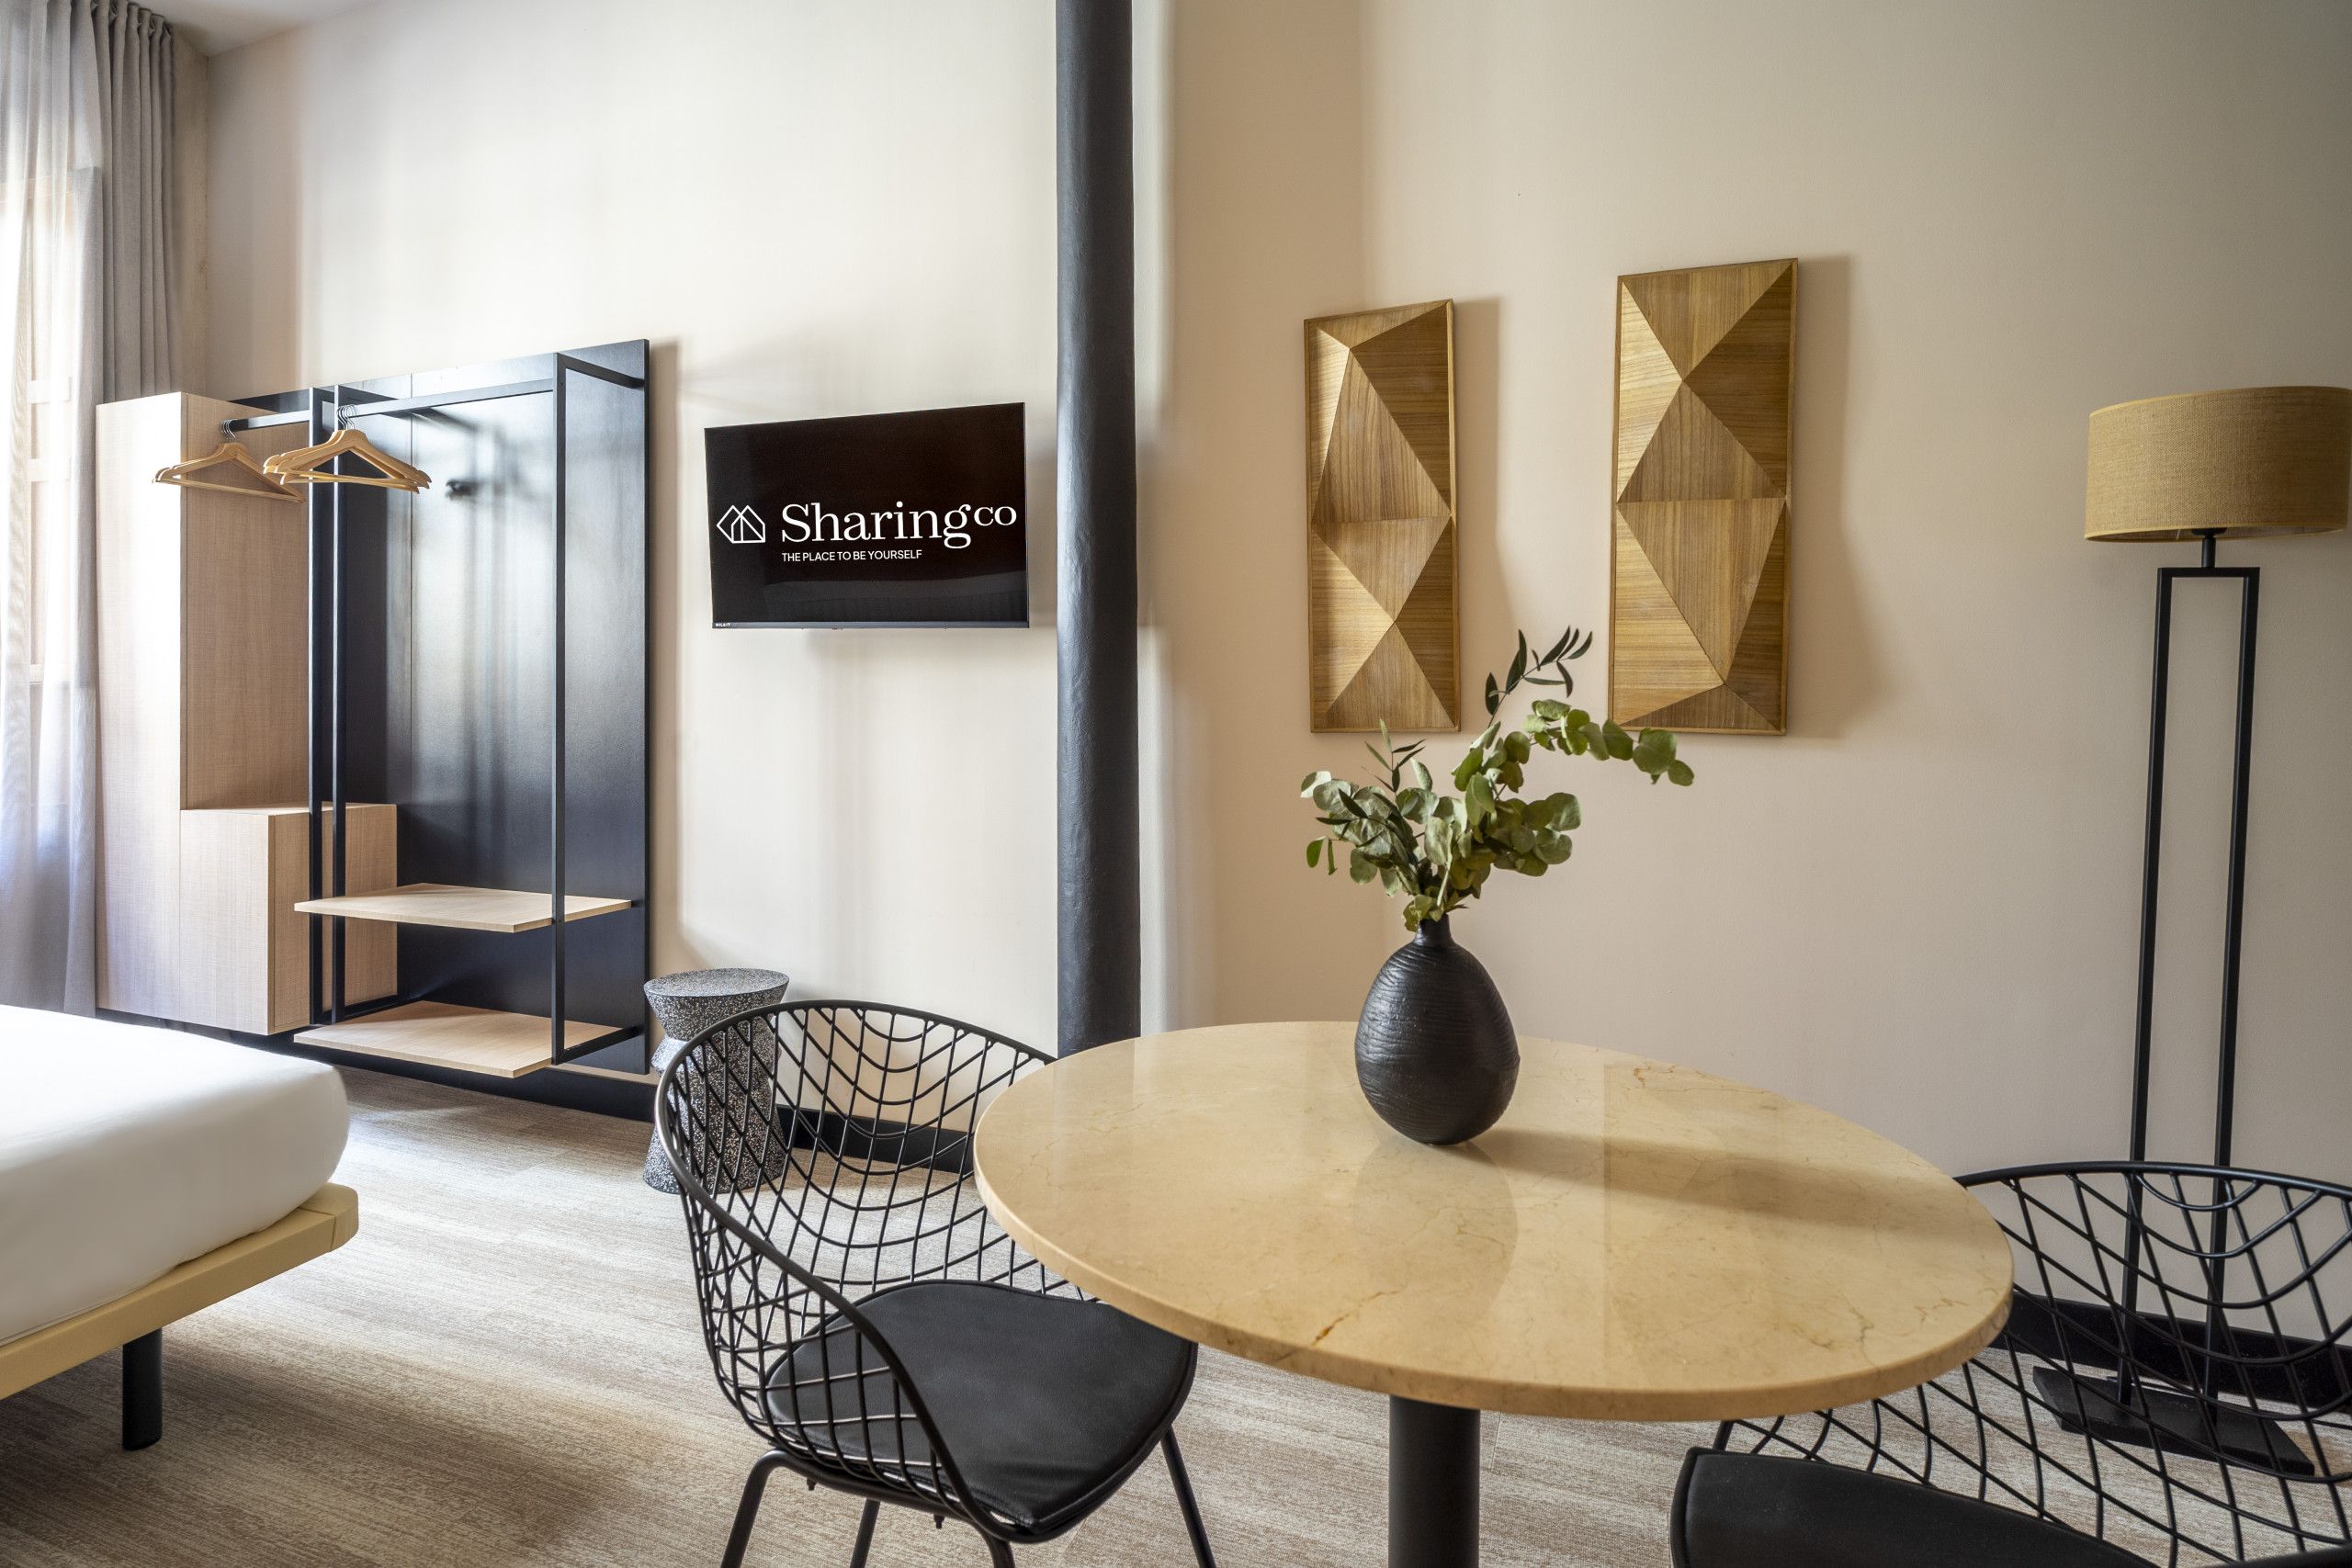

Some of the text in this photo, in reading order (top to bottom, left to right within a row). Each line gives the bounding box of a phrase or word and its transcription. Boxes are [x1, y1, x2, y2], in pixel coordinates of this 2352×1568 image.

[782, 549, 922, 562] THE PLACE TO BE YOURSELF
